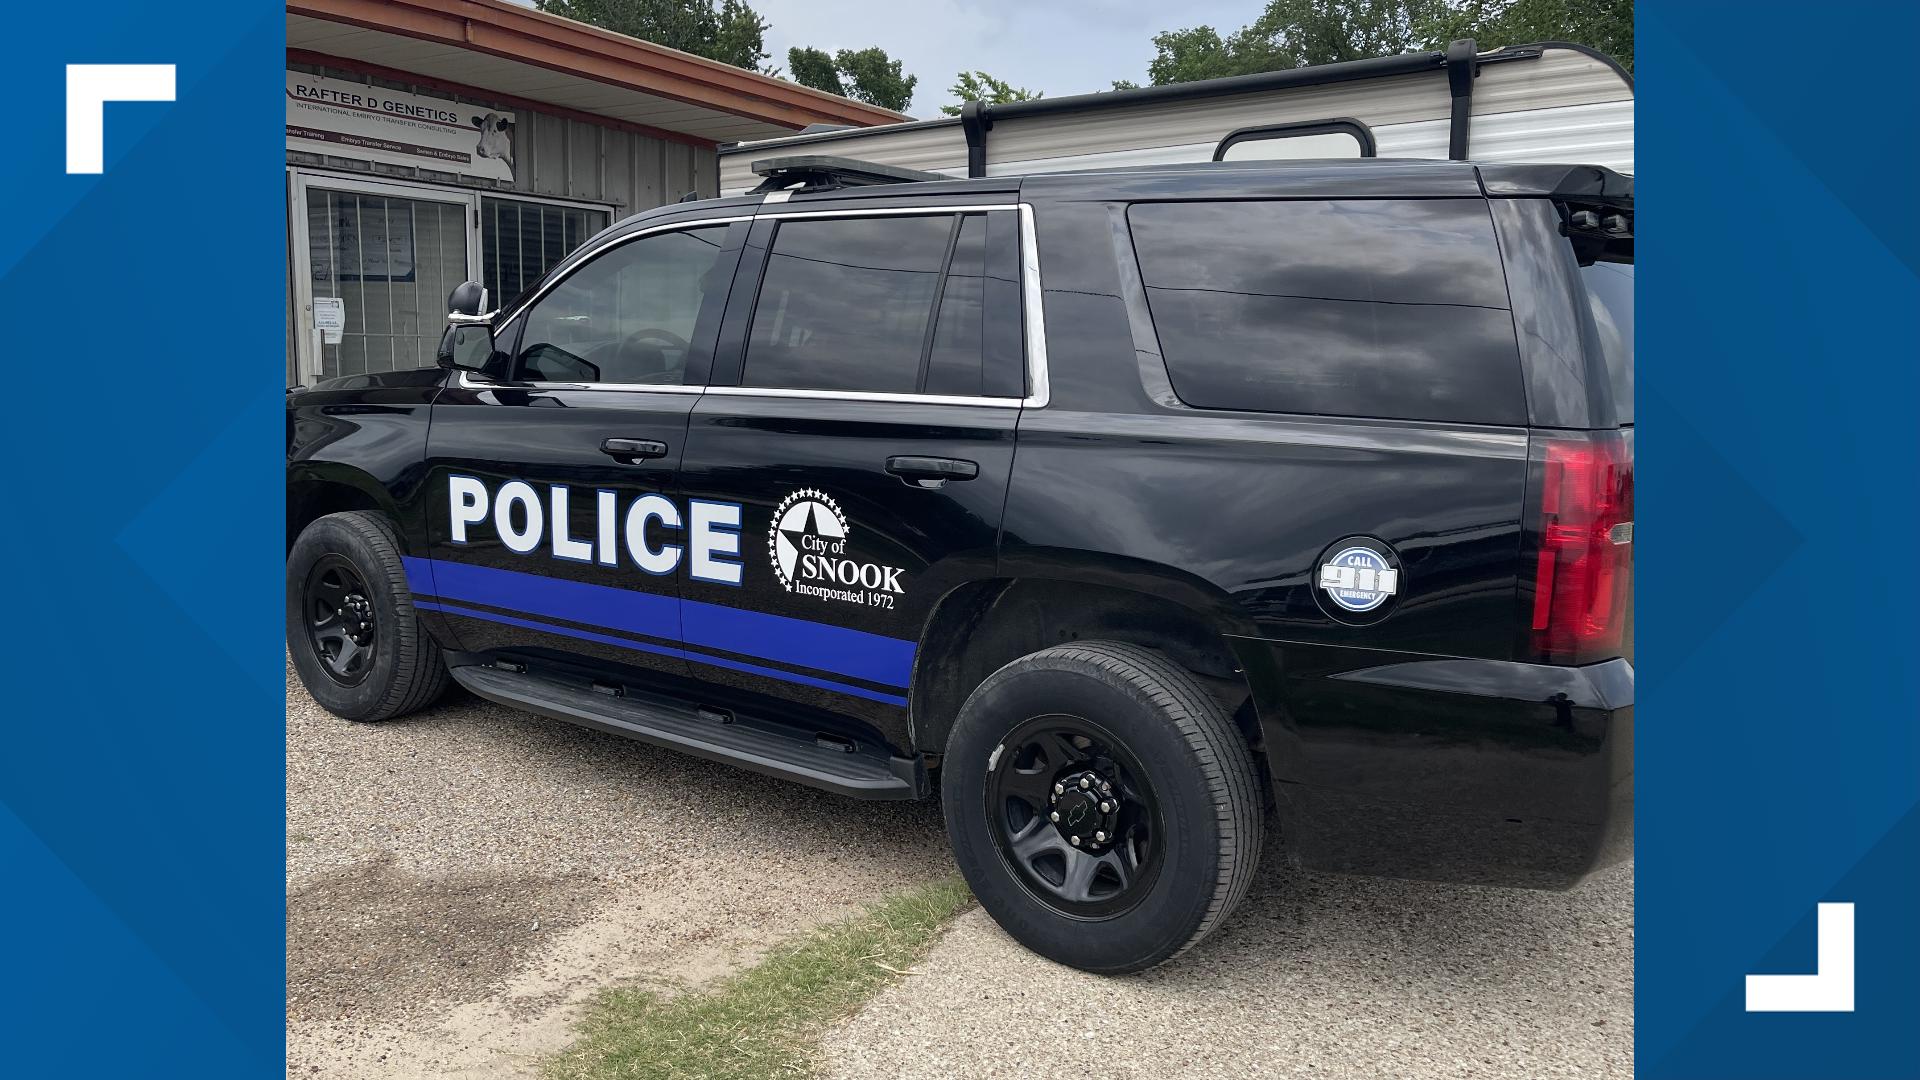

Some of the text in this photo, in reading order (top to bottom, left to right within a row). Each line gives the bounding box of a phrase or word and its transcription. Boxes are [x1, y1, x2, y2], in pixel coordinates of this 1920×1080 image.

[296, 84, 458, 123] RAFTER D GENETICS
[296, 103, 457, 135] INTERNATIONAL EMBRYO TRANSFER CONSULTING
[448, 473, 744, 586] POLICE
[801, 534, 847, 556] City of
[802, 554, 905, 594] SNOOK
[1347, 555, 1373, 568] CALL
[795, 579, 895, 610] Incorporated 1972
[1320, 563, 1398, 595] 911
[1340, 590, 1376, 600] EMERGENCY
